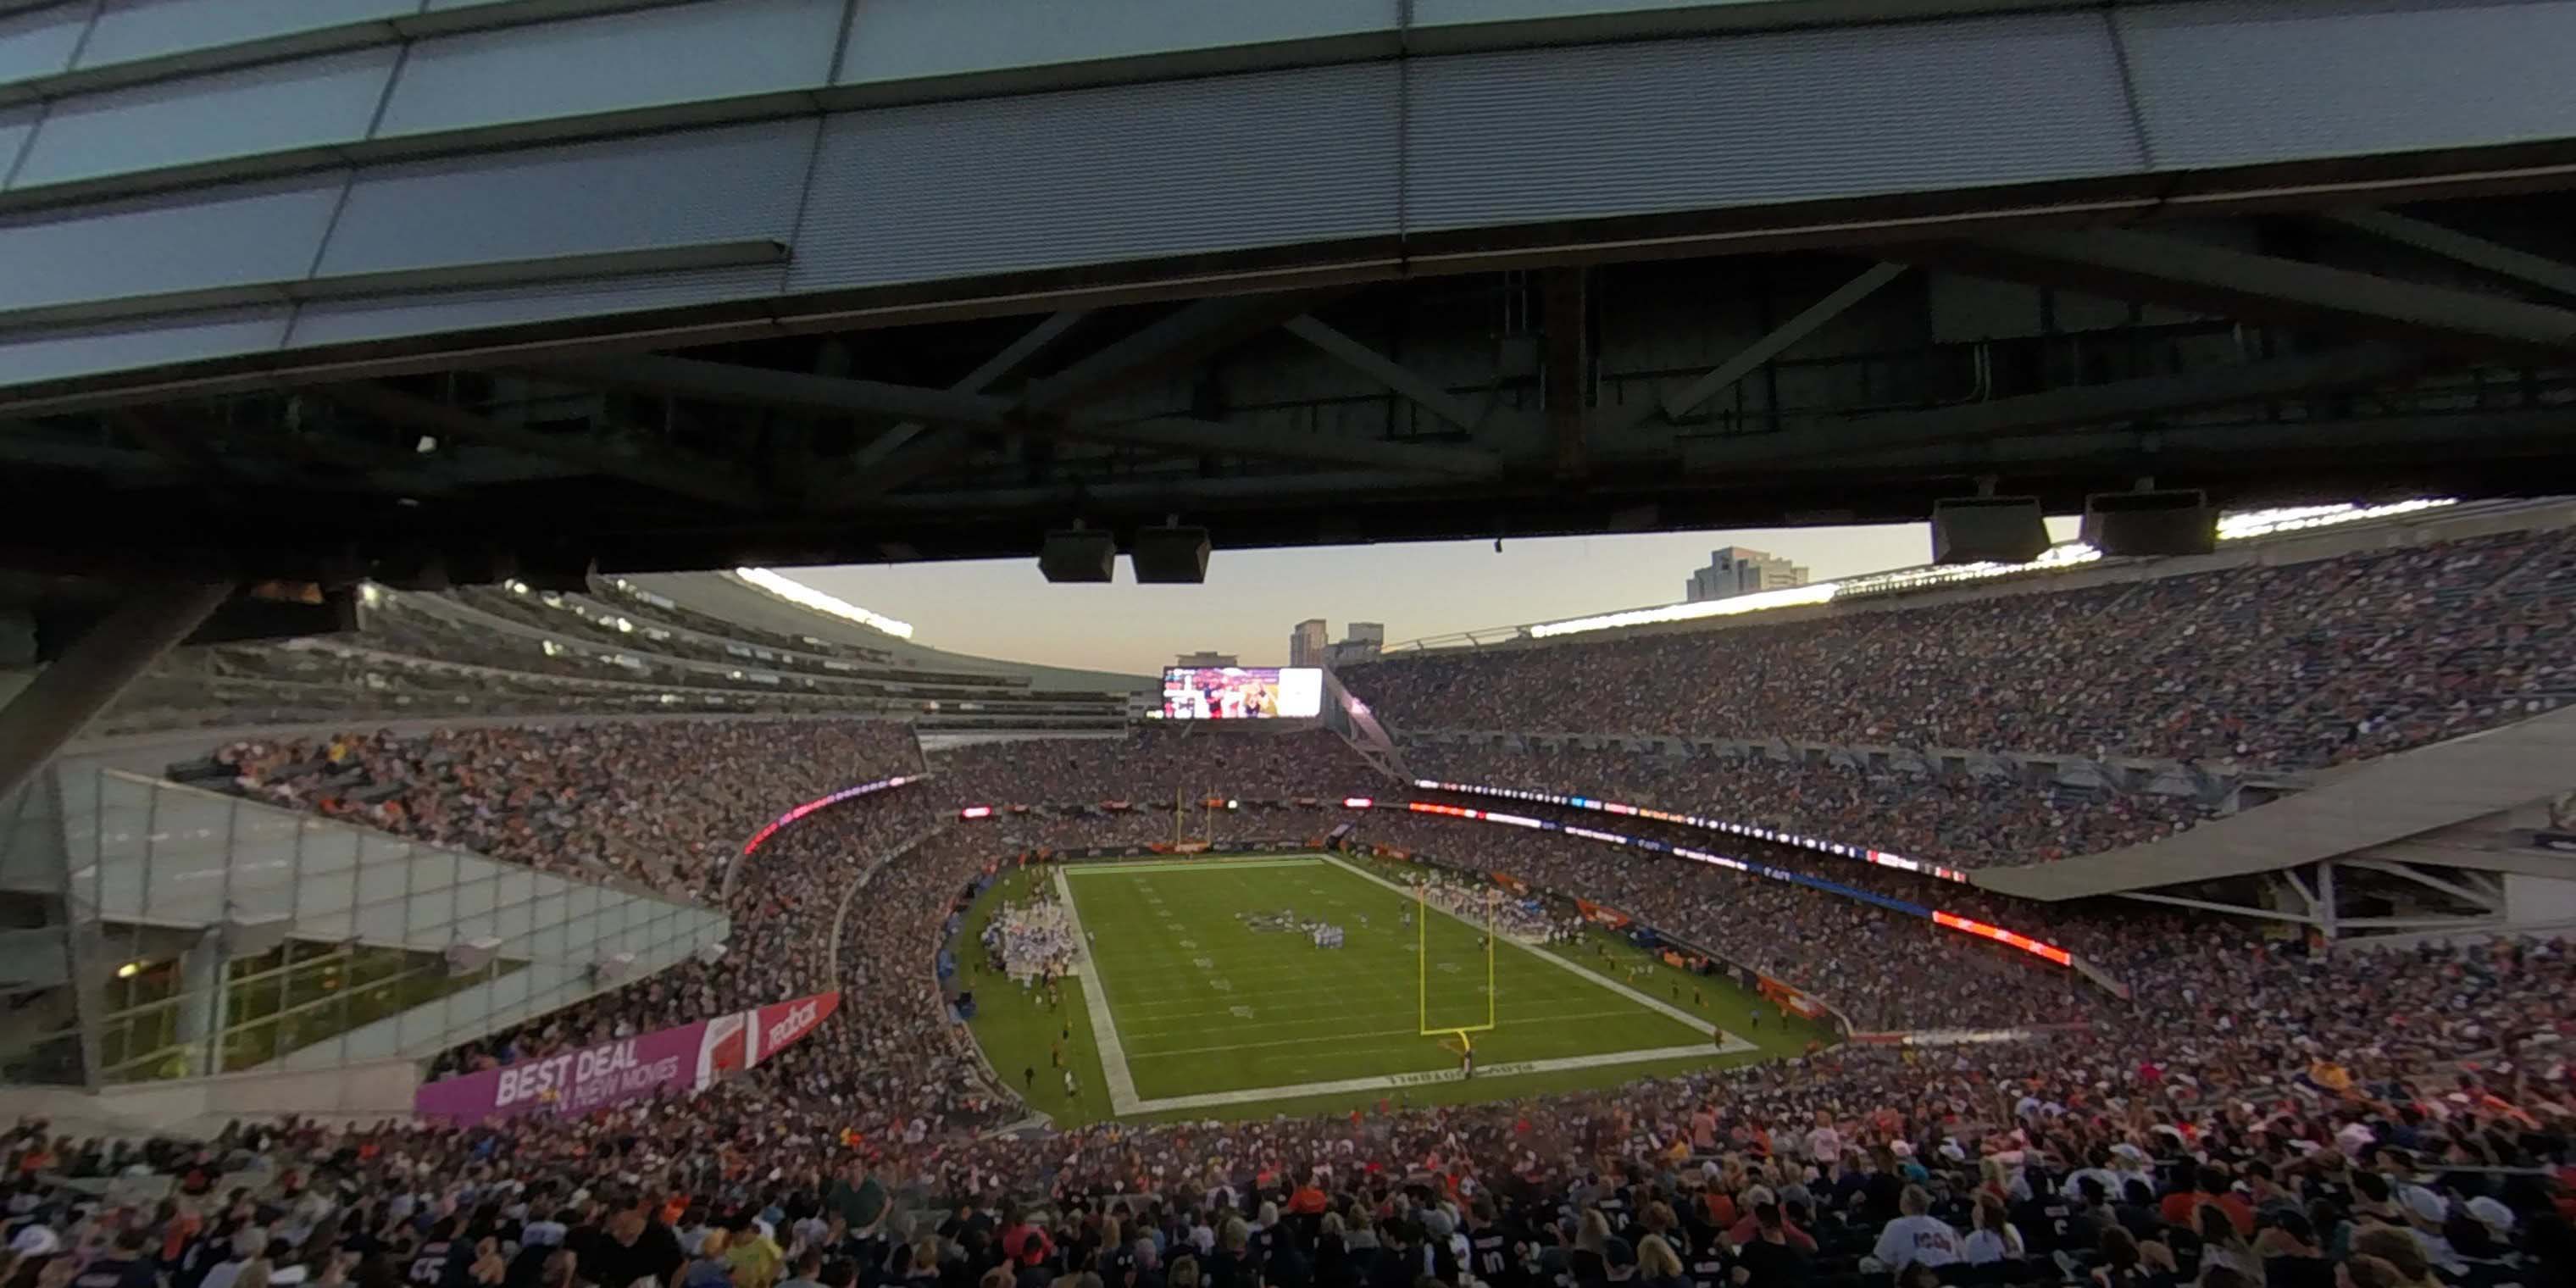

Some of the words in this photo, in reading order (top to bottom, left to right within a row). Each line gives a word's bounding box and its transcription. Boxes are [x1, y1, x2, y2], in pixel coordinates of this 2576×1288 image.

[768, 1000, 819, 1050] redbox
[495, 1054, 570, 1107] BEST
[575, 1039, 639, 1083] DEAL
[575, 1075, 618, 1111] NEW
[621, 1055, 680, 1093] MOVIES
